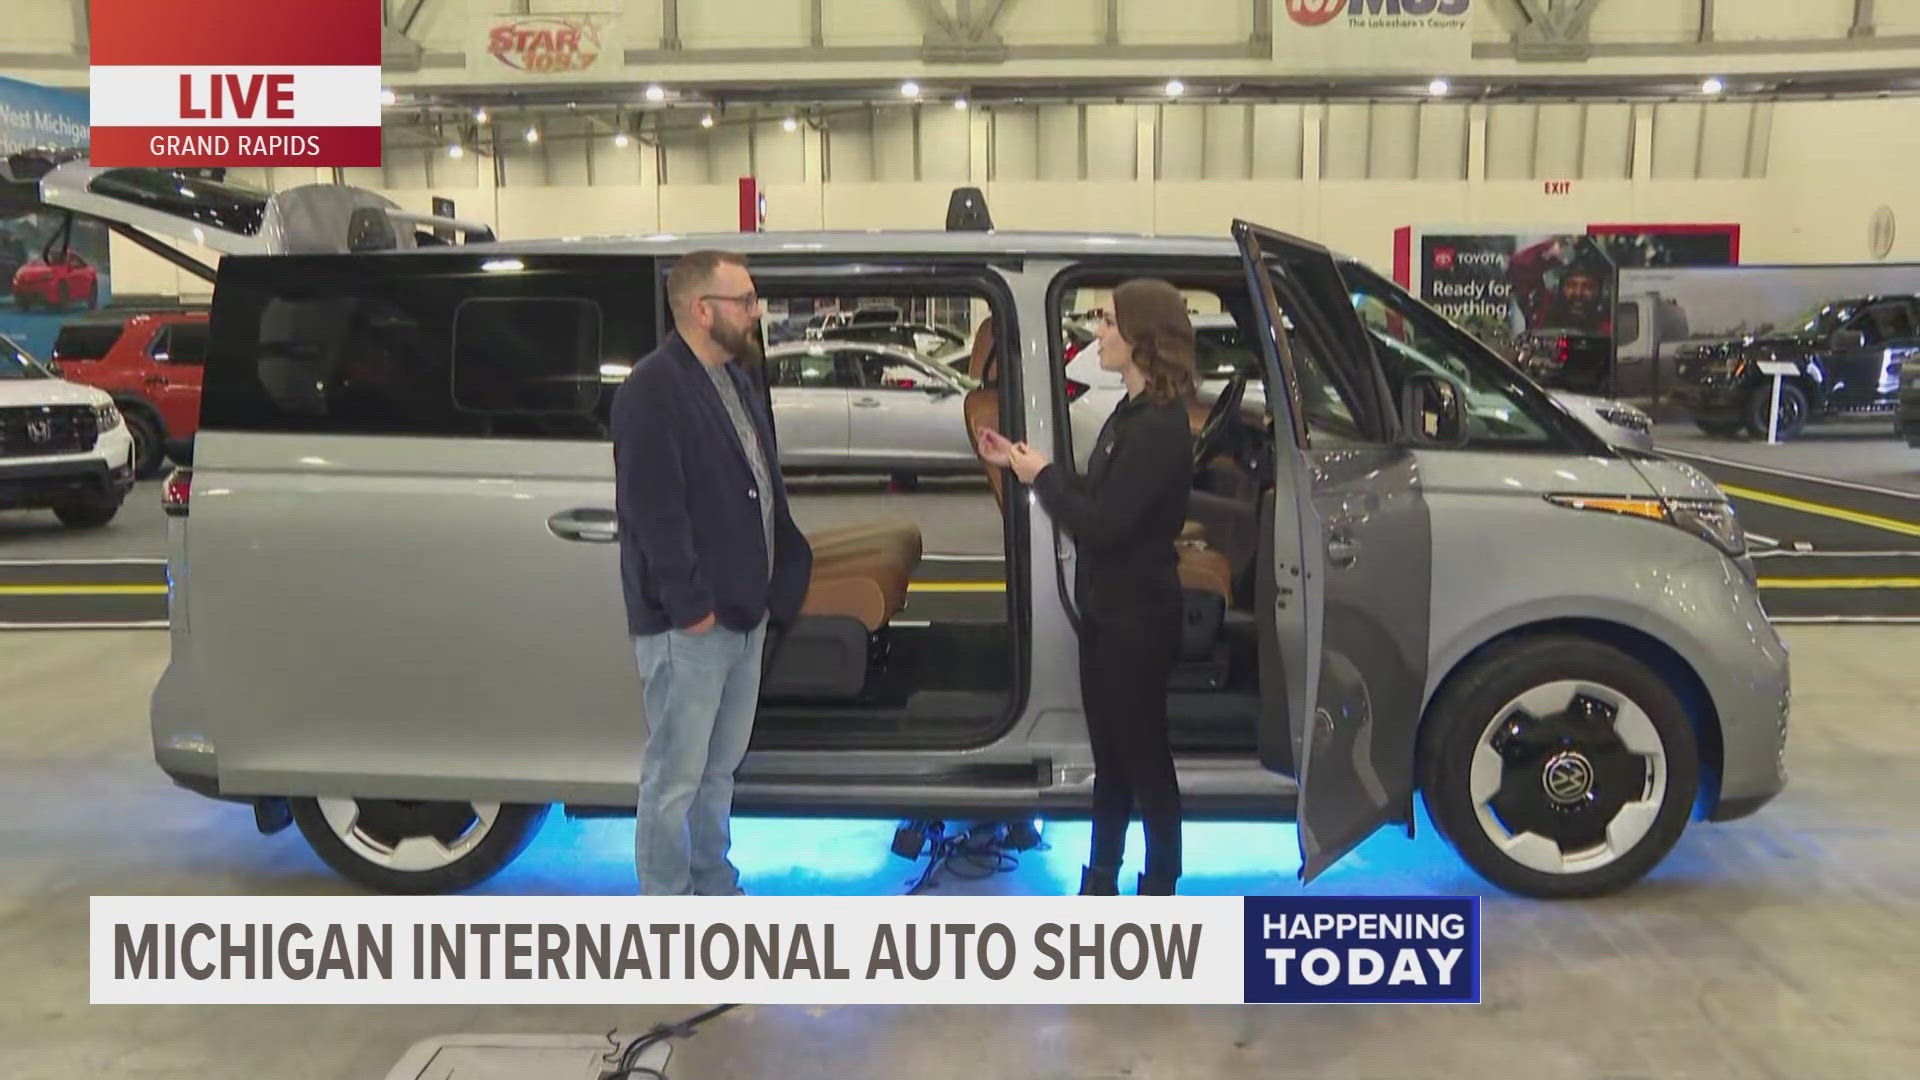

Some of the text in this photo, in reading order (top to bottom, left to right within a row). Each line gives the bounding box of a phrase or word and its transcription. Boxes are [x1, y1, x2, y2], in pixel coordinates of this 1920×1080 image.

[1349, 18, 1465, 30] The Lakeshore's Country
[487, 26, 580, 54] STAR
[1544, 181, 1571, 195] EXIT
[1457, 252, 1505, 266] TOYOTA
[1433, 280, 1512, 300] Ready for
[1434, 299, 1512, 322] anything.
